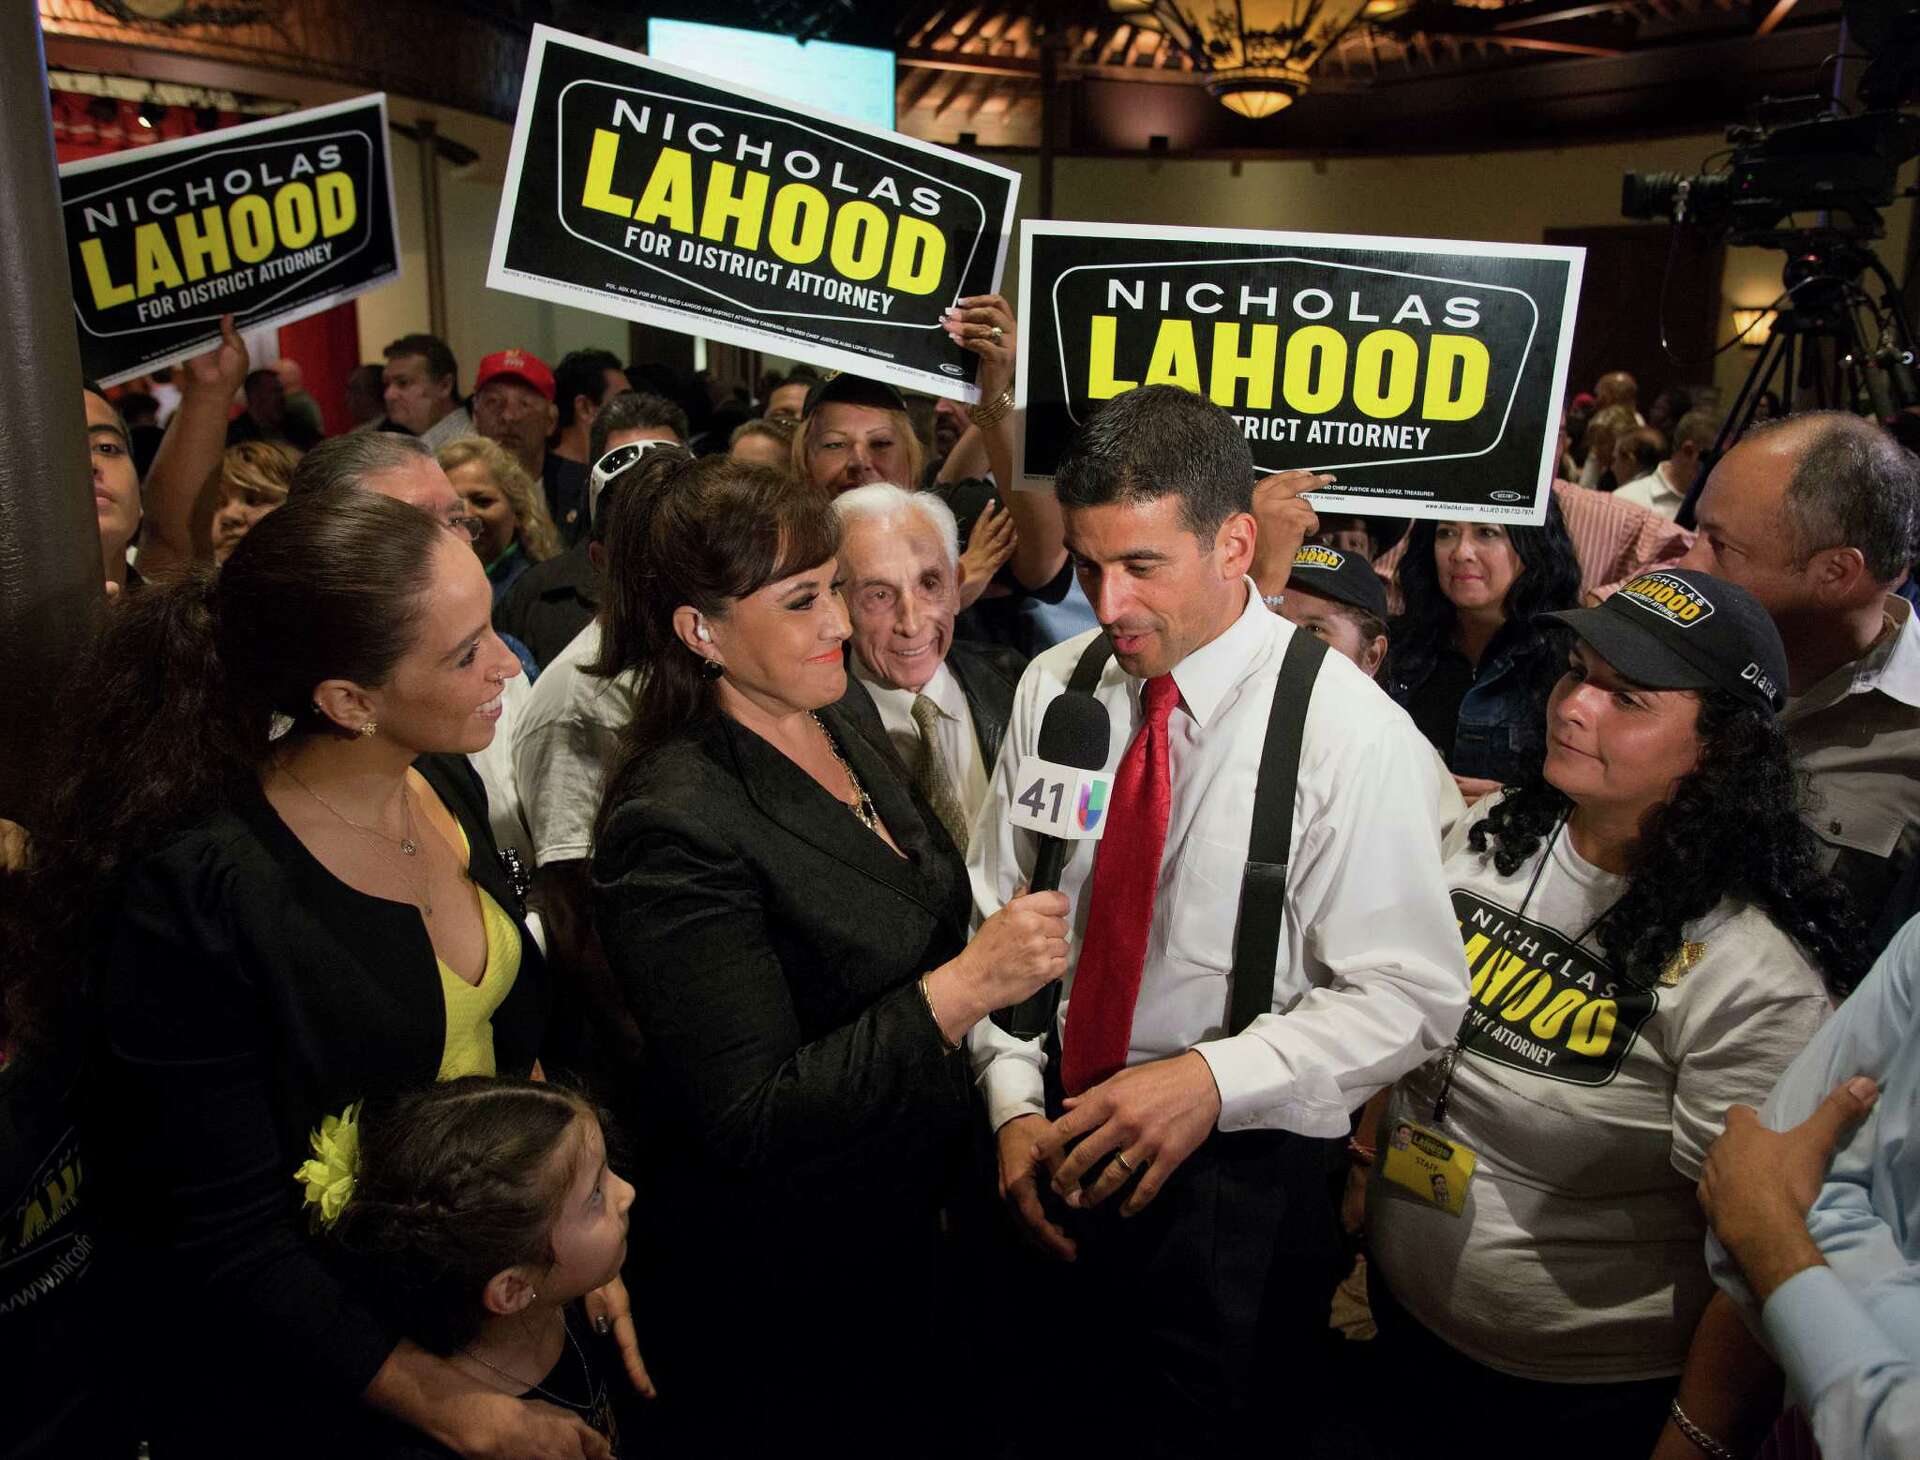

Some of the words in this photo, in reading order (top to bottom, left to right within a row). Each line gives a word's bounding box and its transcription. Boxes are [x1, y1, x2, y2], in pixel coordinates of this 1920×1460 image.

[85, 145, 343, 232] NICHOLAS
[612, 98, 942, 216] NICHOLAS
[80, 171, 357, 311] LAHOOD
[581, 127, 947, 296] LAHOOD
[137, 298, 175, 324] FOR
[178, 267, 256, 312] DISTRICT
[258, 241, 334, 283] ATTORNEY
[624, 225, 672, 258] FOR
[678, 240, 785, 286] DISTRICT
[785, 269, 895, 315] ATTORNEY
[1107, 278, 1482, 329] NICHOLAS
[1087, 314, 1491, 422] LAHOOD
[1231, 414, 1301, 442] TRICT
[1306, 420, 1431, 450] ATTORNEY
[1740, 662, 1777, 700] Diana
[1017, 777, 1065, 822] 41
[1490, 1024, 1557, 1067] ATTORNEY
